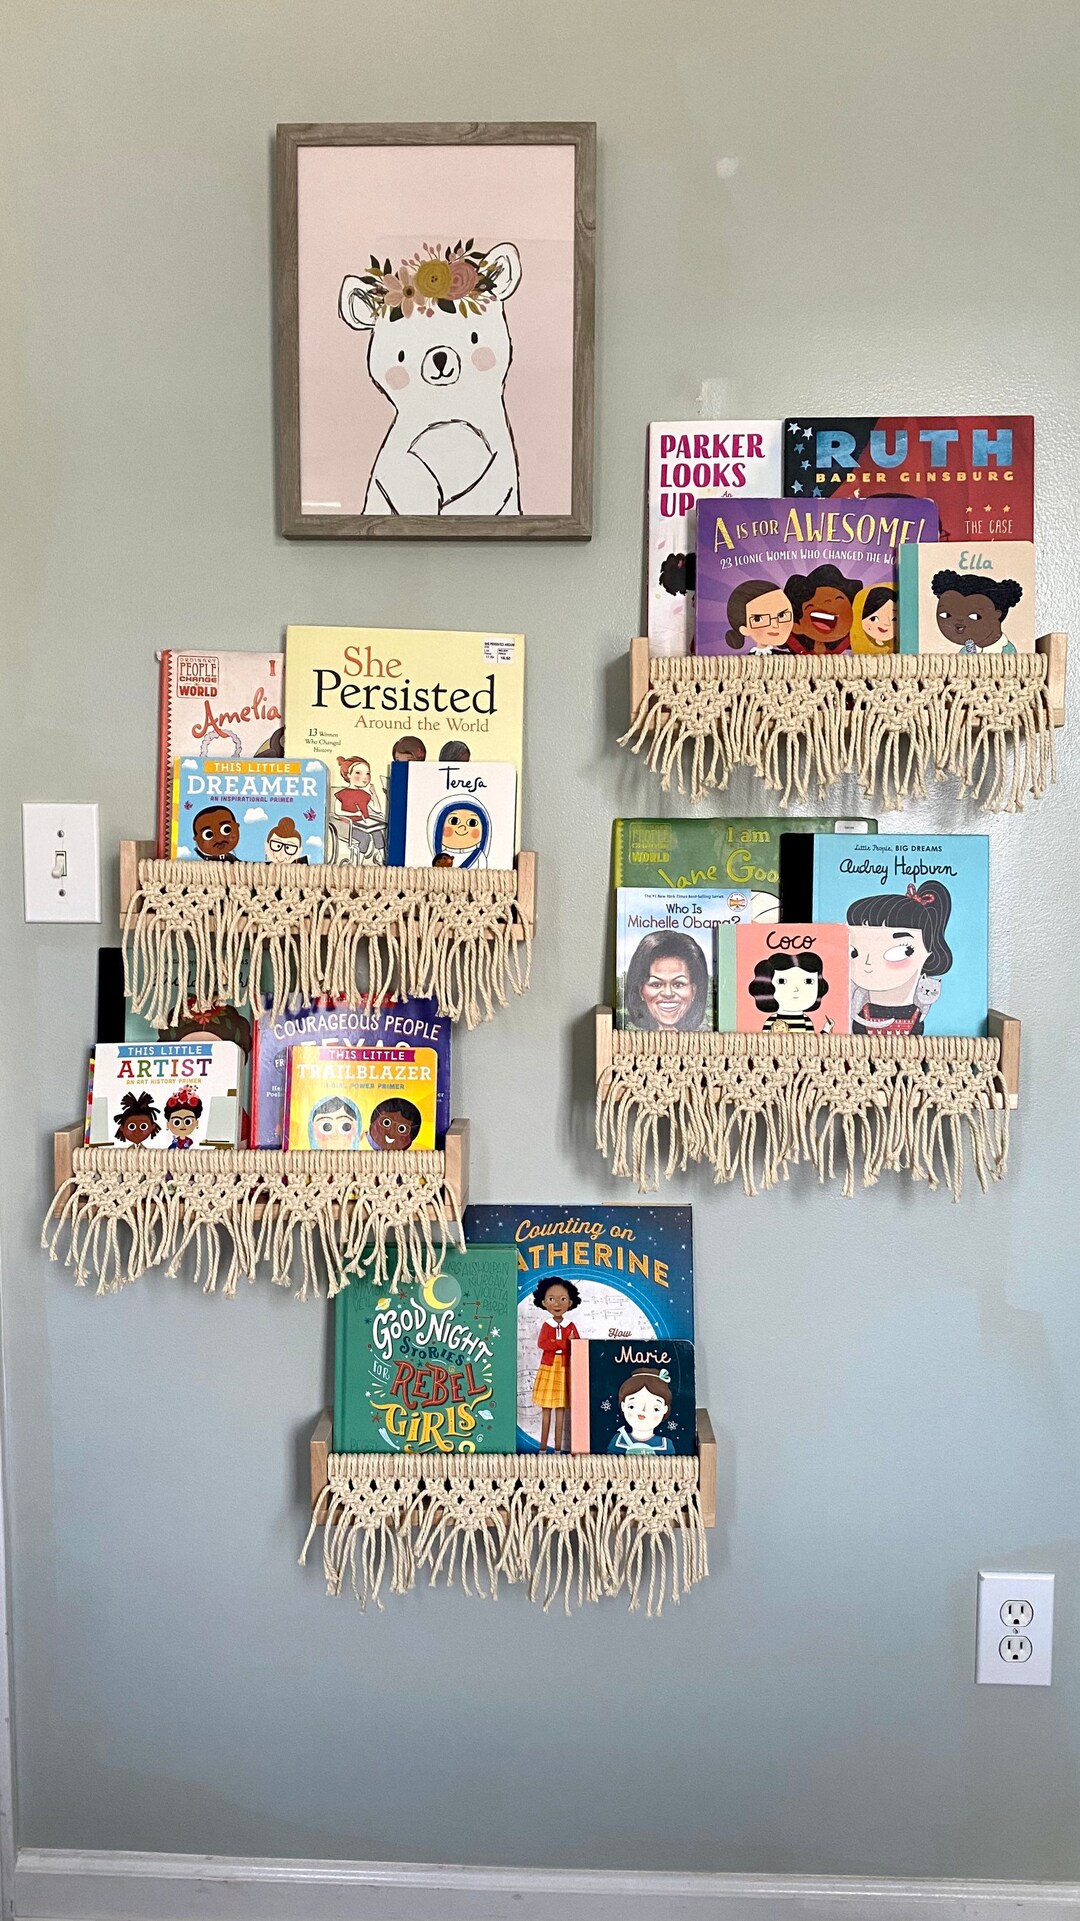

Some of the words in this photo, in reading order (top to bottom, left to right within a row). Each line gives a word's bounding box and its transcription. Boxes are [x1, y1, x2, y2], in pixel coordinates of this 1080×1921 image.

[660, 433, 766, 459] PARKER
[815, 428, 1014, 469] RUTH
[660, 462, 747, 488] LOOKS
[815, 472, 887, 484] BADER
[899, 470, 1014, 483] GINSBURG
[660, 492, 695, 518] UP
[714, 516, 736, 553] A
[736, 522, 749, 540] IS
[752, 519, 779, 538] FOR
[964, 519, 983, 535] THE
[989, 519, 1013, 534] CASE
[720, 558, 733, 570] 23
[735, 554, 763, 567] ICONIC
[767, 550, 798, 562] WOMEN
[800, 548, 820, 560] WHO
[822, 548, 863, 562] CHANGED
[866, 551, 881, 564] THE
[959, 550, 994, 570] Ella
[179, 662, 217, 677] PEOPLE
[268, 659, 276, 677] I
[342, 645, 403, 679] She
[178, 685, 218, 697] WORLD
[311, 668, 498, 715] Persisted
[191, 687, 282, 739] Amelia
[308, 728, 318, 737] 13
[354, 714, 413, 730] Around
[417, 716, 440, 732] the
[445, 717, 490, 733] World
[213, 762, 241, 773] THIS
[248, 762, 291, 773] LITTLE
[187, 775, 318, 797] DREAMER
[438, 766, 488, 793] Teresa
[726, 826, 733, 843] I
[740, 830, 771, 843] am
[839, 858, 888, 885] Audrey
[894, 855, 958, 883] Hepburn
[665, 903, 690, 914] Who
[691, 903, 703, 914] Is
[627, 915, 679, 929] Michelle
[766, 931, 817, 950] Coco
[273, 1013, 380, 1041] COURAGEOUS
[384, 1015, 442, 1042] PEOPLE
[127, 1046, 155, 1056] THIS
[160, 1045, 203, 1056] LITTLE
[329, 1050, 357, 1060] THIS
[363, 1050, 405, 1061] LITTLE
[116, 1058, 213, 1078] ARTIST
[297, 1063, 432, 1081] TRAILBLAZER
[514, 1218, 607, 1243] Counting
[609, 1225, 637, 1242] on
[517, 1241, 670, 1288] ATHERINE
[415, 1310, 494, 1362] NIGHT
[608, 1327, 633, 1339] How
[400, 1336, 465, 1366] STORIES
[614, 1345, 672, 1365] Marie
[372, 1360, 391, 1381] FOR
[389, 1360, 488, 1410] REBEL
